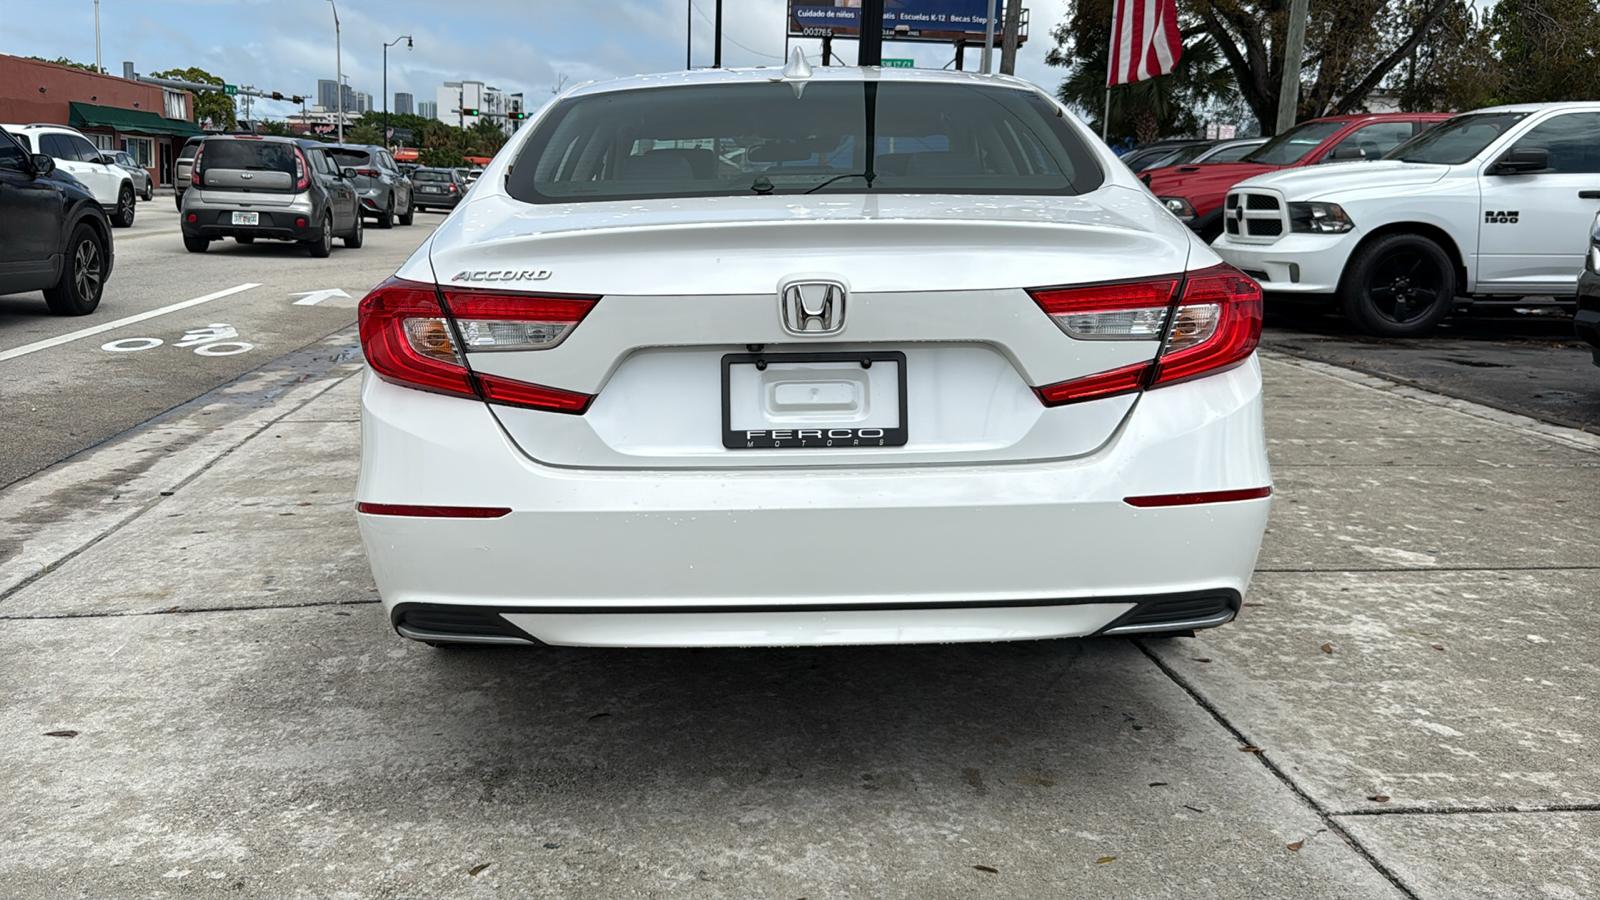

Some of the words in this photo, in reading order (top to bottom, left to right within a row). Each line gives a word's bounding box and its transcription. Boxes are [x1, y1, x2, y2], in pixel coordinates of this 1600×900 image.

[797, 9, 826, 17] Cuidado
[826, 10, 836, 18] de
[836, 10, 855, 19] niños
[882, 12, 895, 20] atis
[900, 13, 930, 21] Escuelas
[930, 14, 946, 22] K-12
[950, 15, 971, 23] Becas
[972, 15, 987, 25] Step
[451, 270, 553, 282] ACCORD
[746, 428, 884, 440] FERCO
[746, 439, 884, 448] MOTORS
